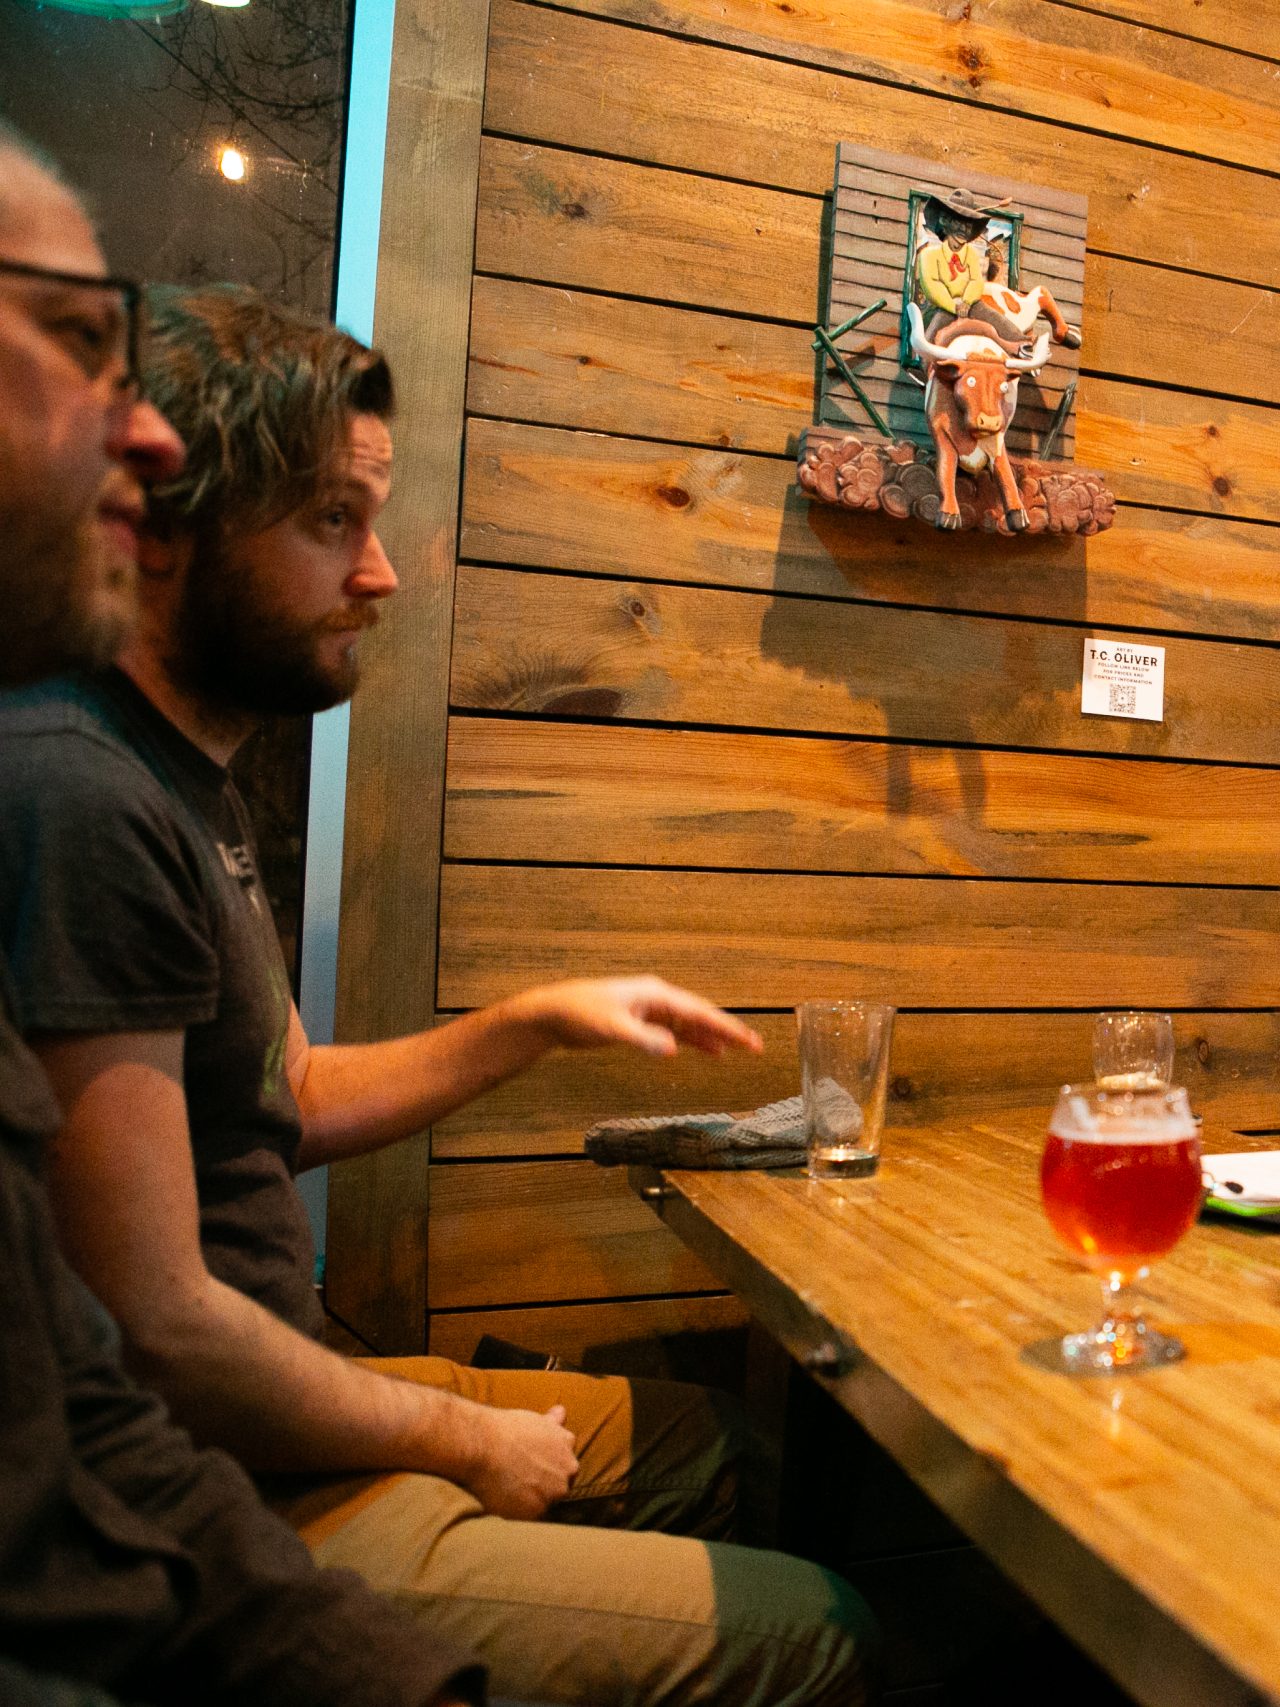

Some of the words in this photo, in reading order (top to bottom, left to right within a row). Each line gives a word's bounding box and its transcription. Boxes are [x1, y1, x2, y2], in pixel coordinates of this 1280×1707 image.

[1090, 649, 1111, 661] T.C.
[1114, 653, 1158, 667] OLIVER
[1118, 677, 1153, 685] INFORMATION
